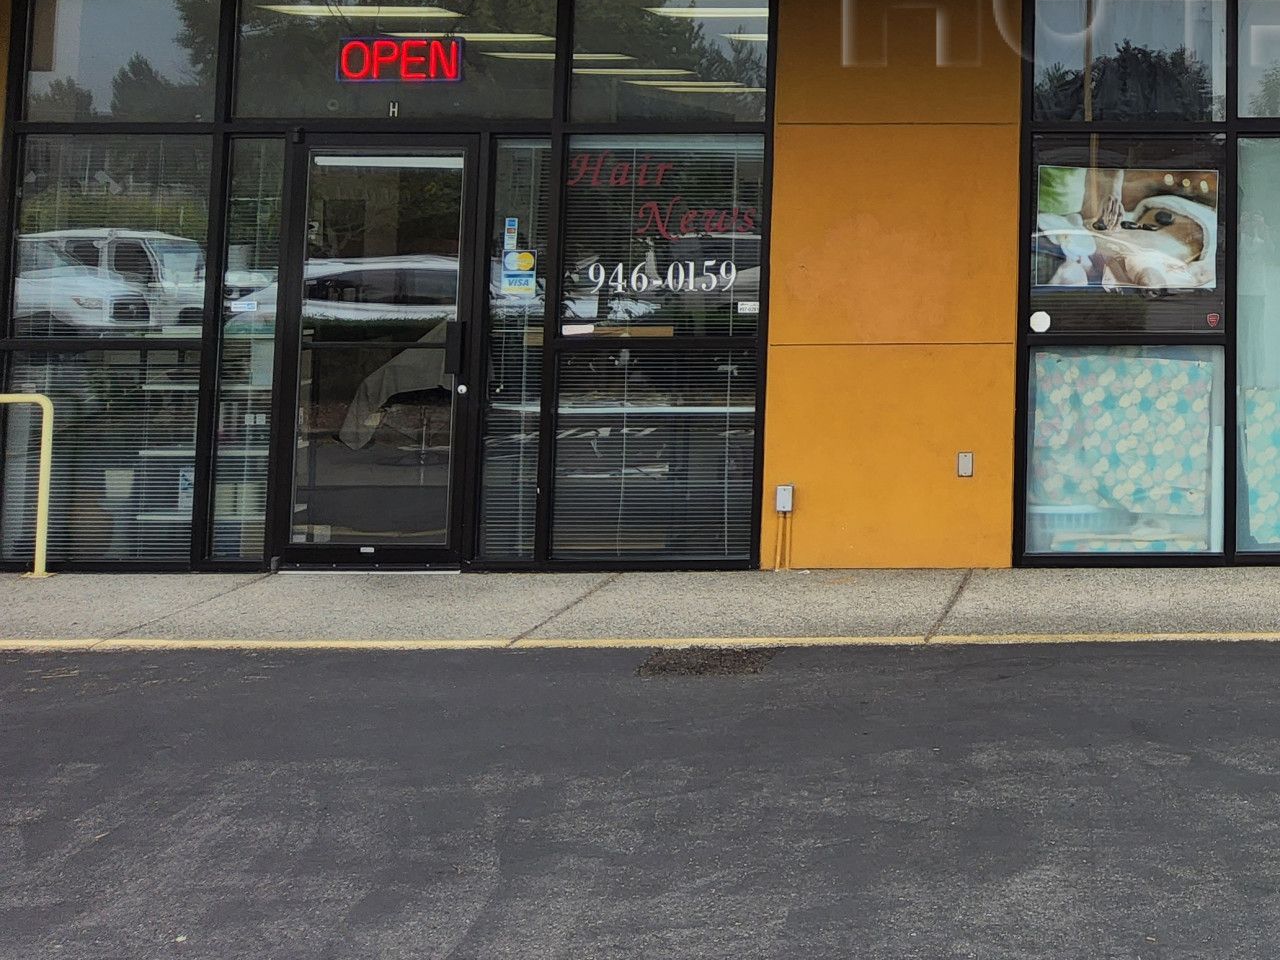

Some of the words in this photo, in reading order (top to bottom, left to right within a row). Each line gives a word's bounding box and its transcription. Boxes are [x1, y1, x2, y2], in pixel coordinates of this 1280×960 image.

[341, 40, 458, 79] OPEN
[389, 102, 399, 117] H
[567, 150, 673, 187] Hair
[635, 196, 757, 242] News
[508, 279, 529, 287] VISA
[588, 260, 738, 294] 946-0159
